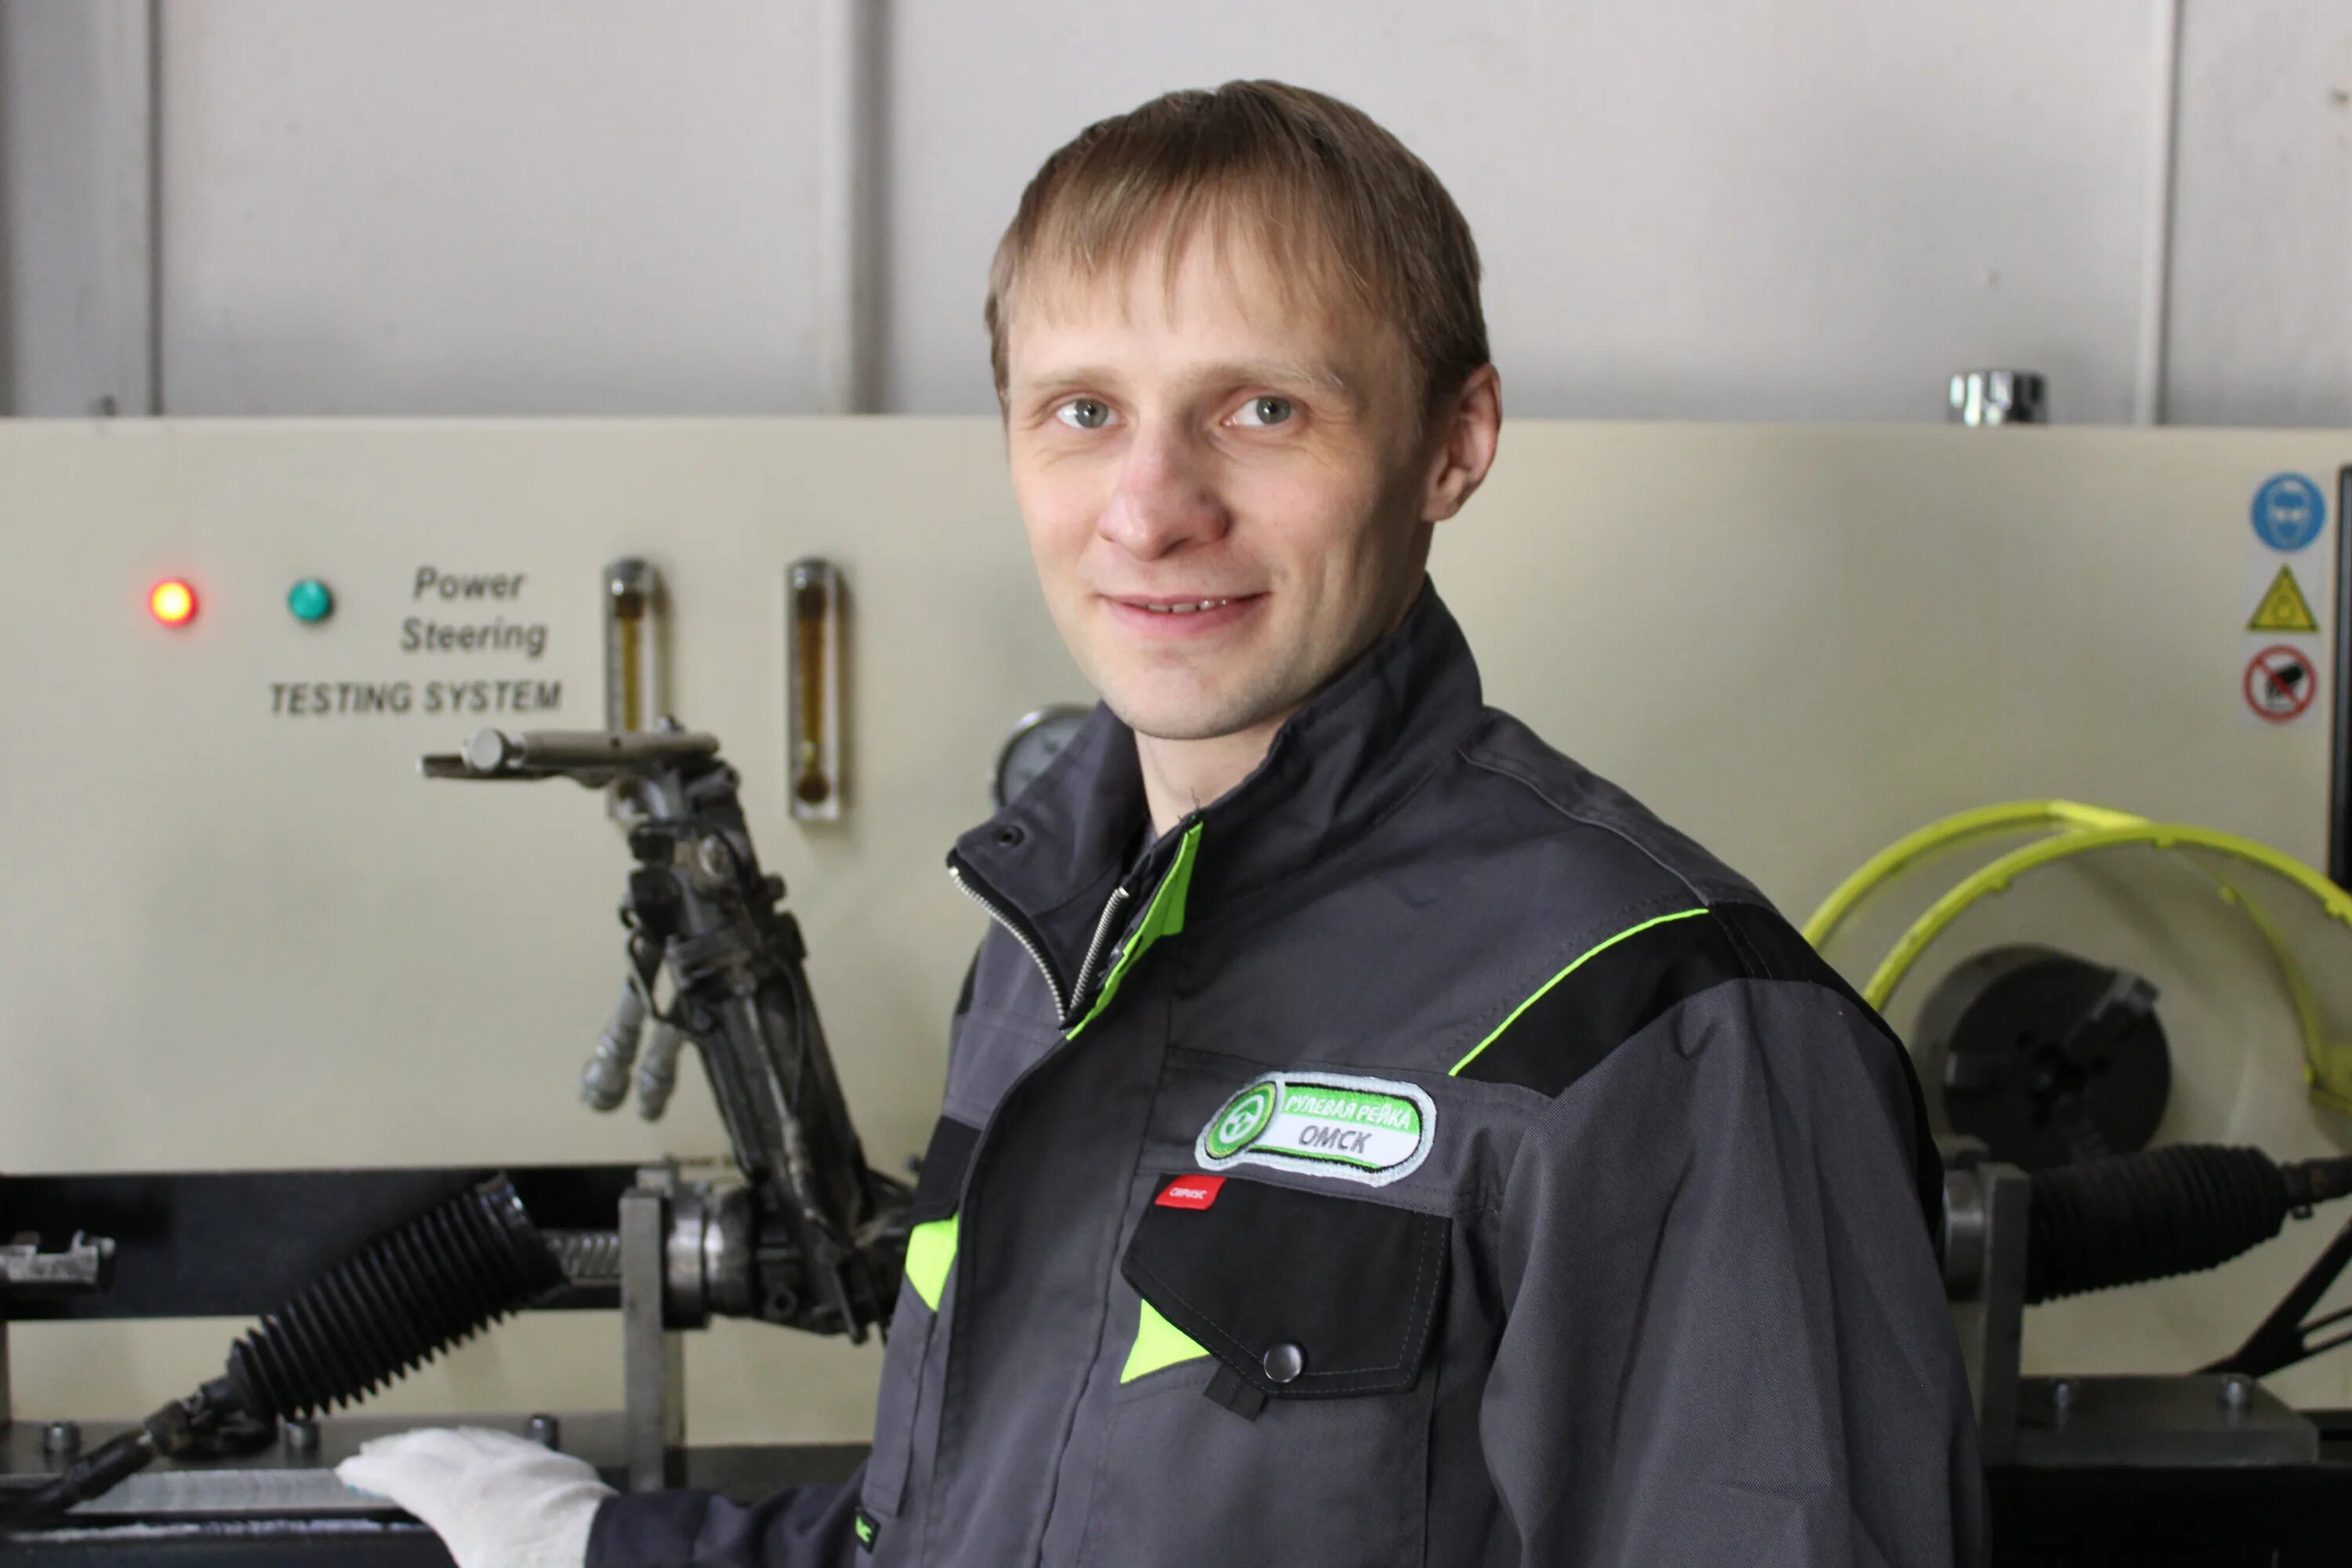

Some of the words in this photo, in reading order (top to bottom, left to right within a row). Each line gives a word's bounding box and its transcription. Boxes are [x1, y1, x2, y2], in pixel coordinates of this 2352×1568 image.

[413, 565, 525, 600] Power
[401, 616, 548, 659] Steering
[270, 681, 413, 715] TESTING
[424, 680, 563, 713] SYSTEM
[1284, 1095, 1357, 1119] РУЛЕВАЯ
[1356, 1102, 1411, 1130] РЕЙКА
[1298, 1124, 1373, 1154] ОМСК
